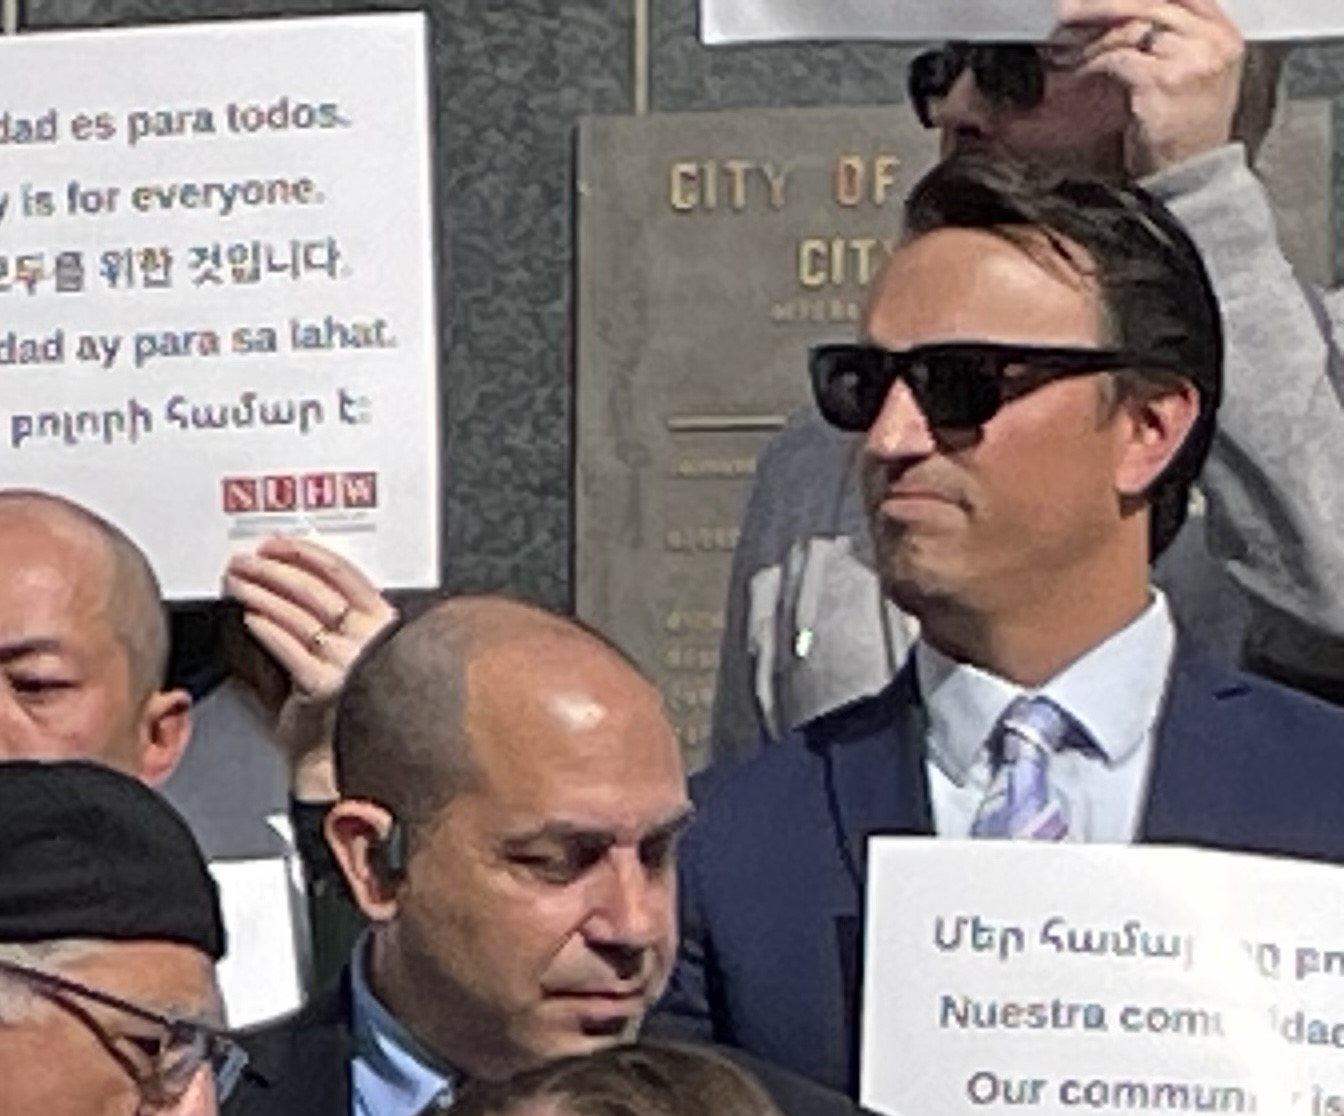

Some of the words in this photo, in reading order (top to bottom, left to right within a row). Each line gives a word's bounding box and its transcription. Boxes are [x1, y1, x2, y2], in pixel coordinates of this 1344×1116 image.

[70, 111, 117, 142] es
[127, 108, 217, 148] para
[225, 95, 351, 134] todos.
[20, 183, 56, 217] is
[66, 180, 121, 216] for
[130, 177, 324, 217] everyone.
[670, 156, 797, 212] CITY
[836, 154, 900, 207] OF
[99, 246, 174, 289] 위한
[187, 235, 351, 288] 것입니다.
[75, 335, 123, 370] ay
[133, 330, 221, 369] para
[231, 327, 278, 355] sa
[288, 314, 396, 351] lahat.
[222, 472, 377, 512] NUHW
[939, 994, 1109, 1032] Nuestra
[966, 1070, 1048, 1106] Our
